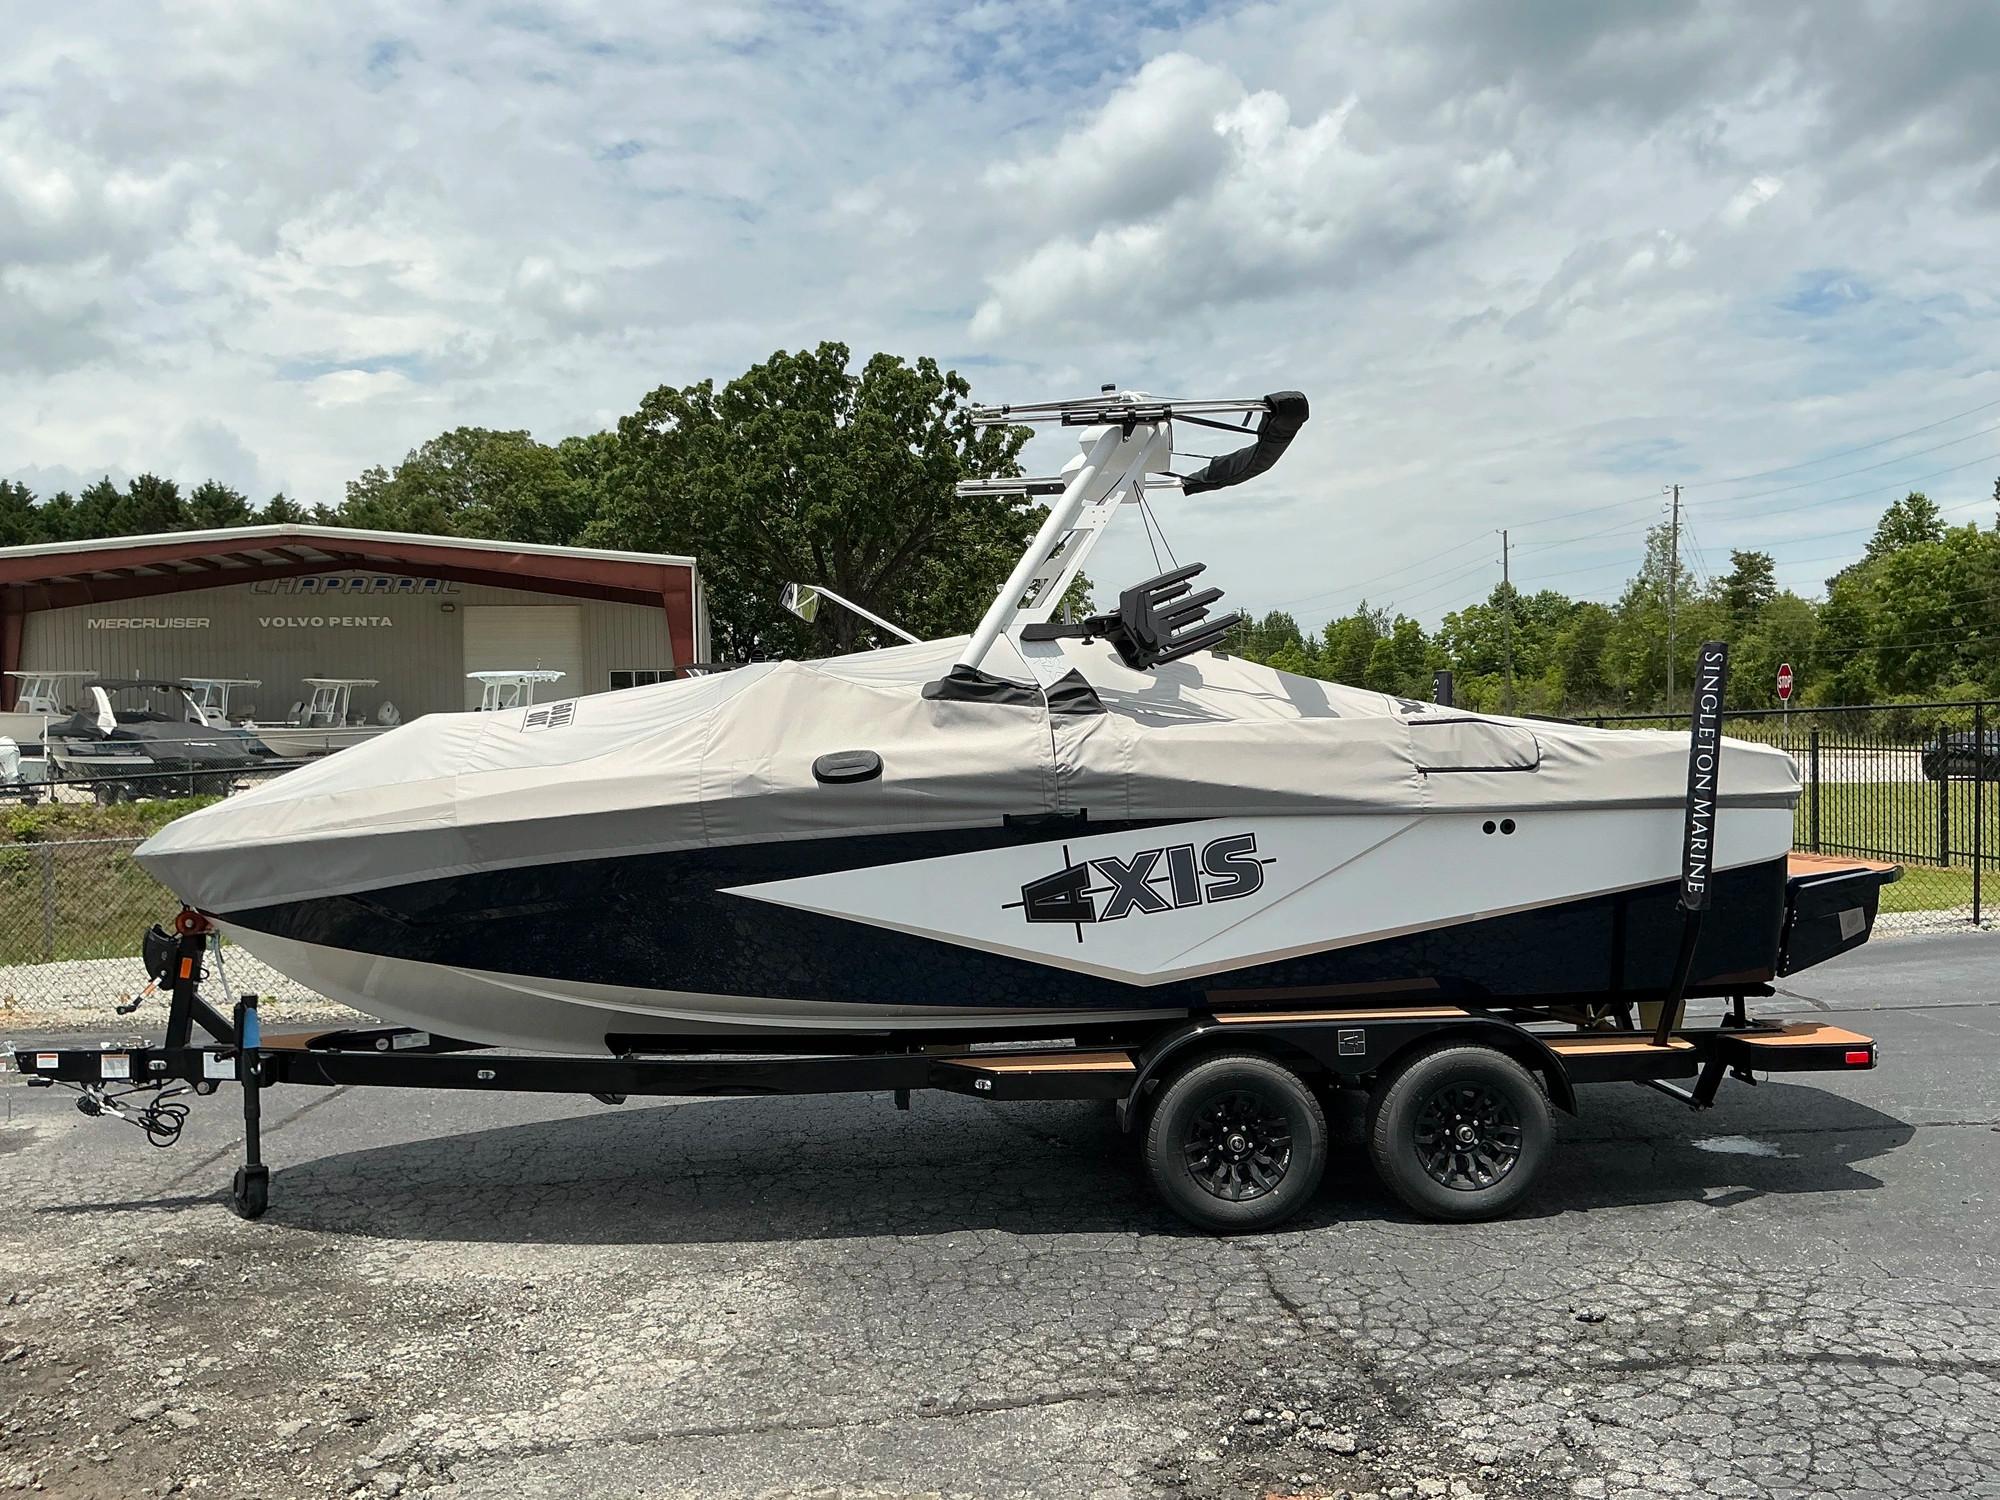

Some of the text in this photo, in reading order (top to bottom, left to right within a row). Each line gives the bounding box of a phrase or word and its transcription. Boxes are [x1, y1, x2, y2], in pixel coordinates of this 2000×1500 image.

[250, 576, 461, 595] CHAPARRAL
[87, 617, 210, 629] MERCRUISER
[258, 616, 393, 628] VOLVO PENTA
[1778, 675, 1792, 689] STOP
[551, 702, 573, 715] GO
[1687, 652, 1724, 893] SINGLETON MARINE
[1021, 832, 1265, 924] AXIS
